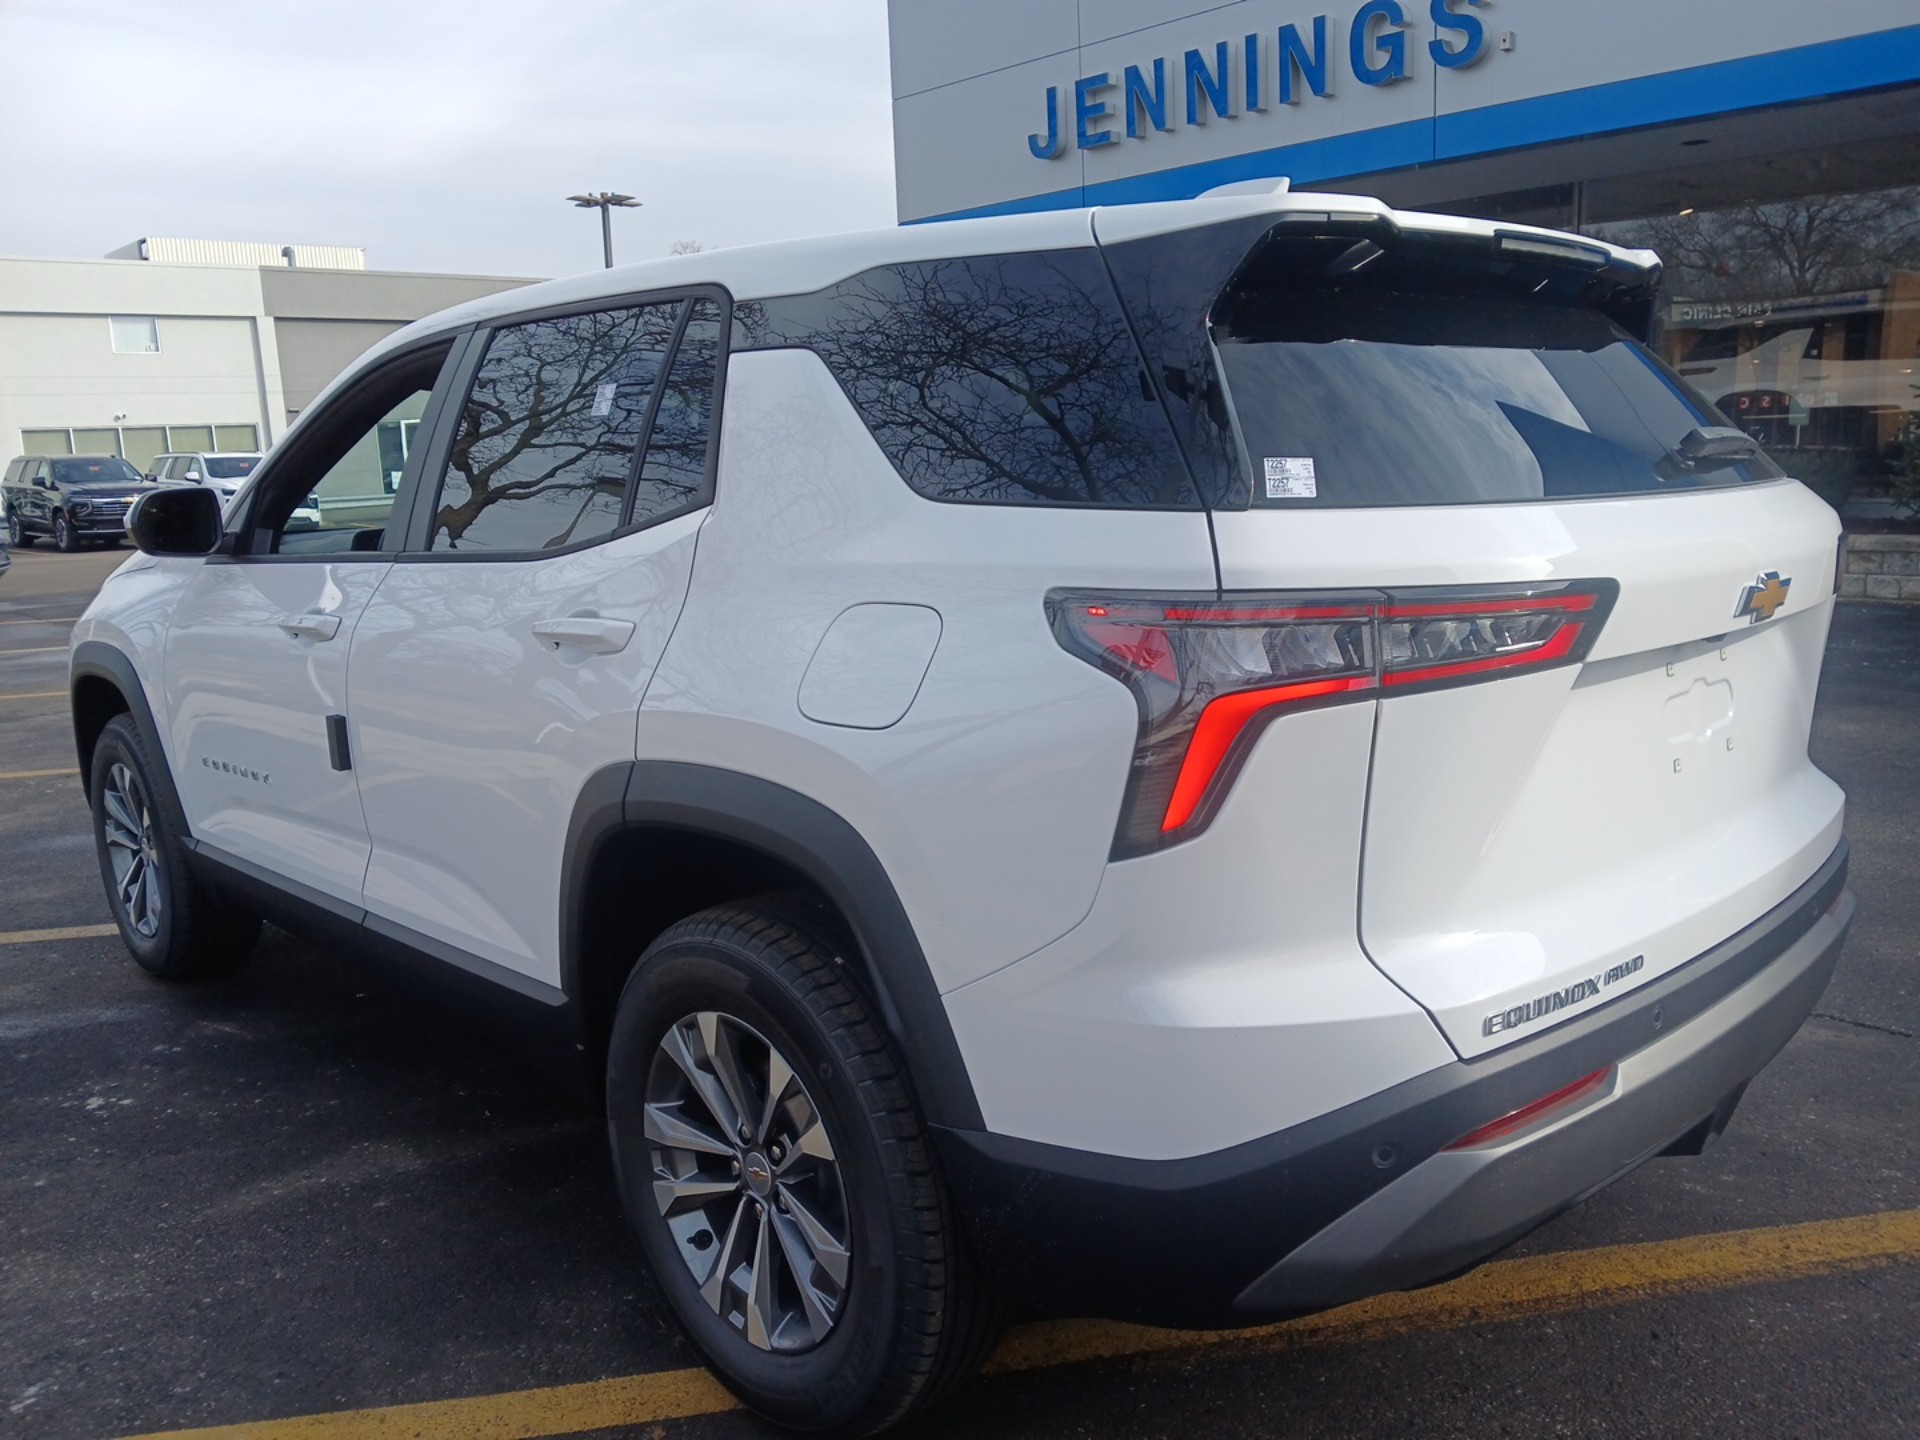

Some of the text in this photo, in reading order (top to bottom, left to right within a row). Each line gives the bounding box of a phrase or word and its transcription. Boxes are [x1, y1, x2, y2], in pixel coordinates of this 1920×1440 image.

[1028, 0, 1491, 160] JENNINGS
[1482, 954, 1645, 1037] EQUINOX AWD
